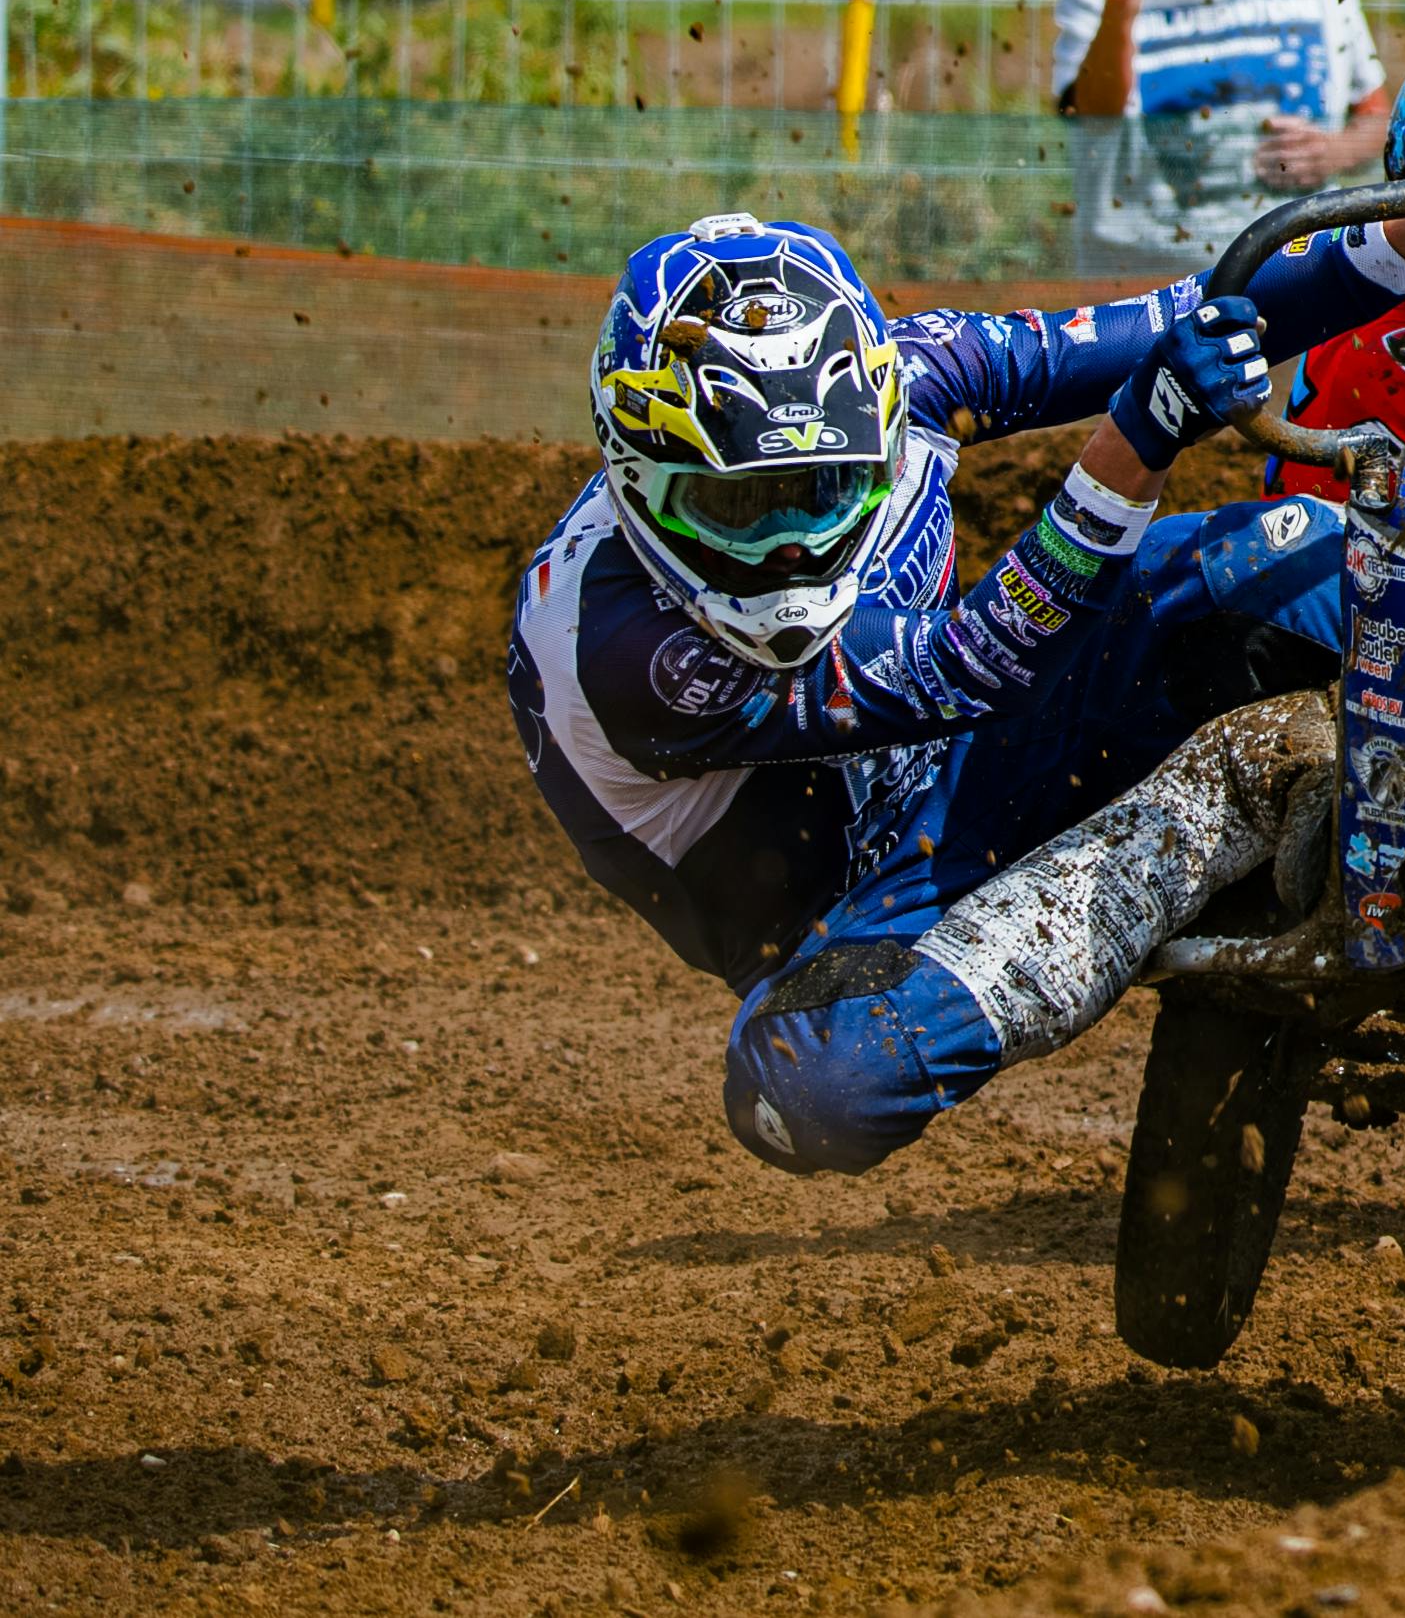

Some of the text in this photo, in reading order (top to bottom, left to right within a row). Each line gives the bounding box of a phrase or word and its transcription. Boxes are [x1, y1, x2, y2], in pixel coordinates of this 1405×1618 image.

[757, 421, 848, 453] SVO
[1001, 567, 1067, 629] REIGER
[1358, 656, 1393, 681] weert
